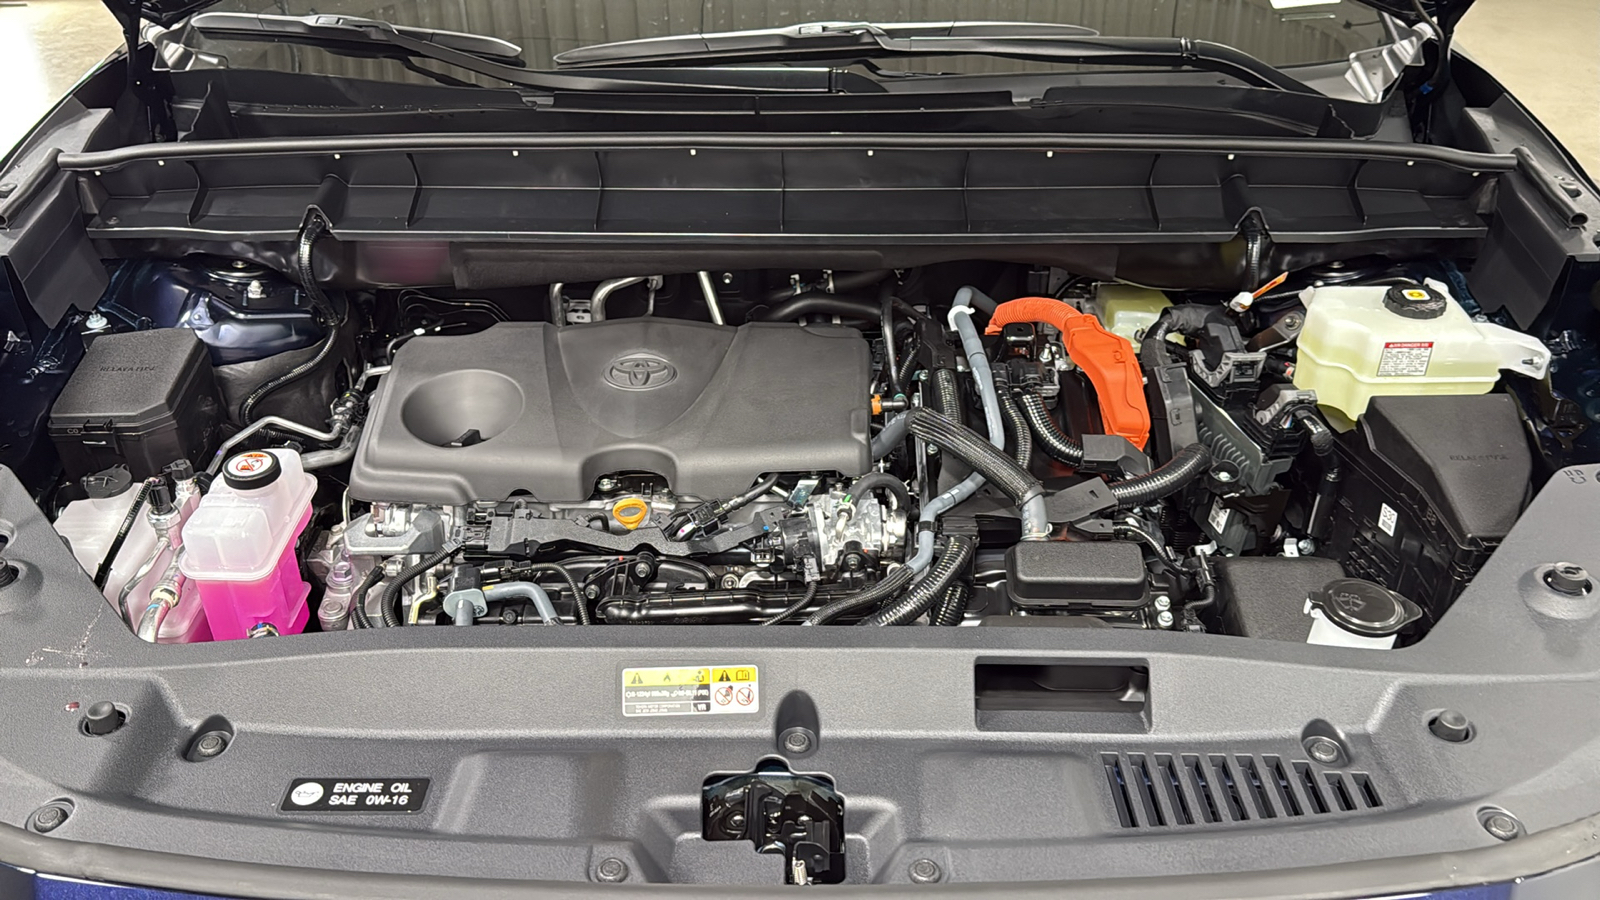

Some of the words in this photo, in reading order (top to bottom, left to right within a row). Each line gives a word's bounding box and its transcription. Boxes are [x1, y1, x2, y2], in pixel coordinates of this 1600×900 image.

[333, 782, 384, 793] ENGINE
[390, 782, 412, 793] OIL
[328, 795, 358, 805] SAE
[365, 795, 409, 805] 0W-16
